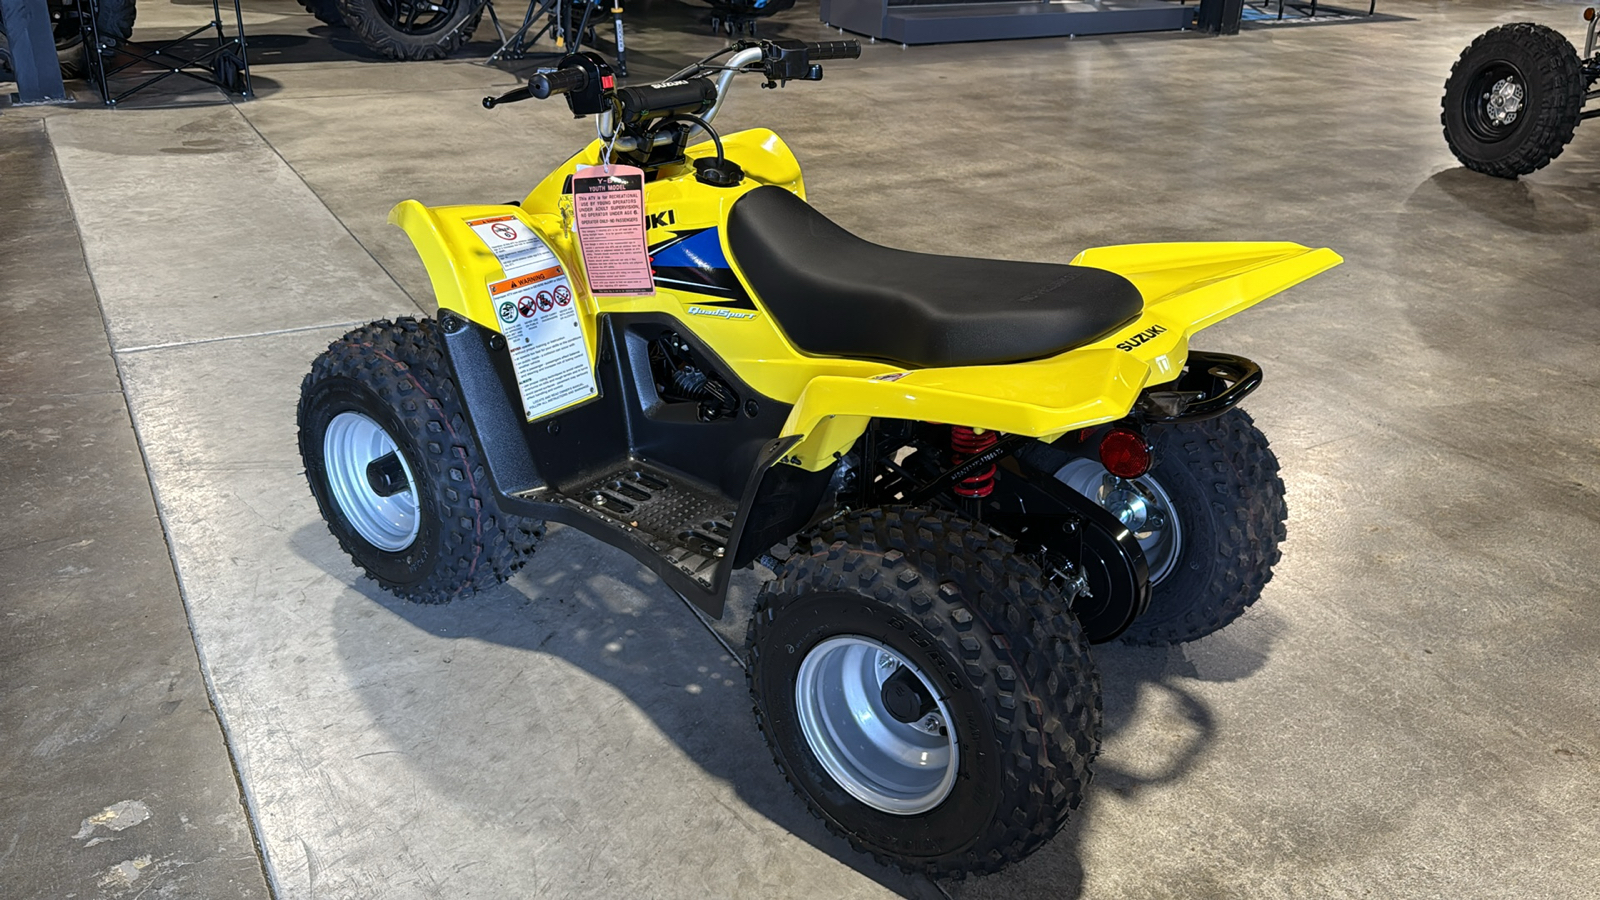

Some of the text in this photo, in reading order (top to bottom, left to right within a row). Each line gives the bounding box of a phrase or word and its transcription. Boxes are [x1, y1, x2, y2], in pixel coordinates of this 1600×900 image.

[650, 80, 689, 89] SUZUKI
[518, 273, 545, 285] WARNING
[688, 306, 756, 319] QuadSport
[1116, 324, 1168, 352] SUZUKI
